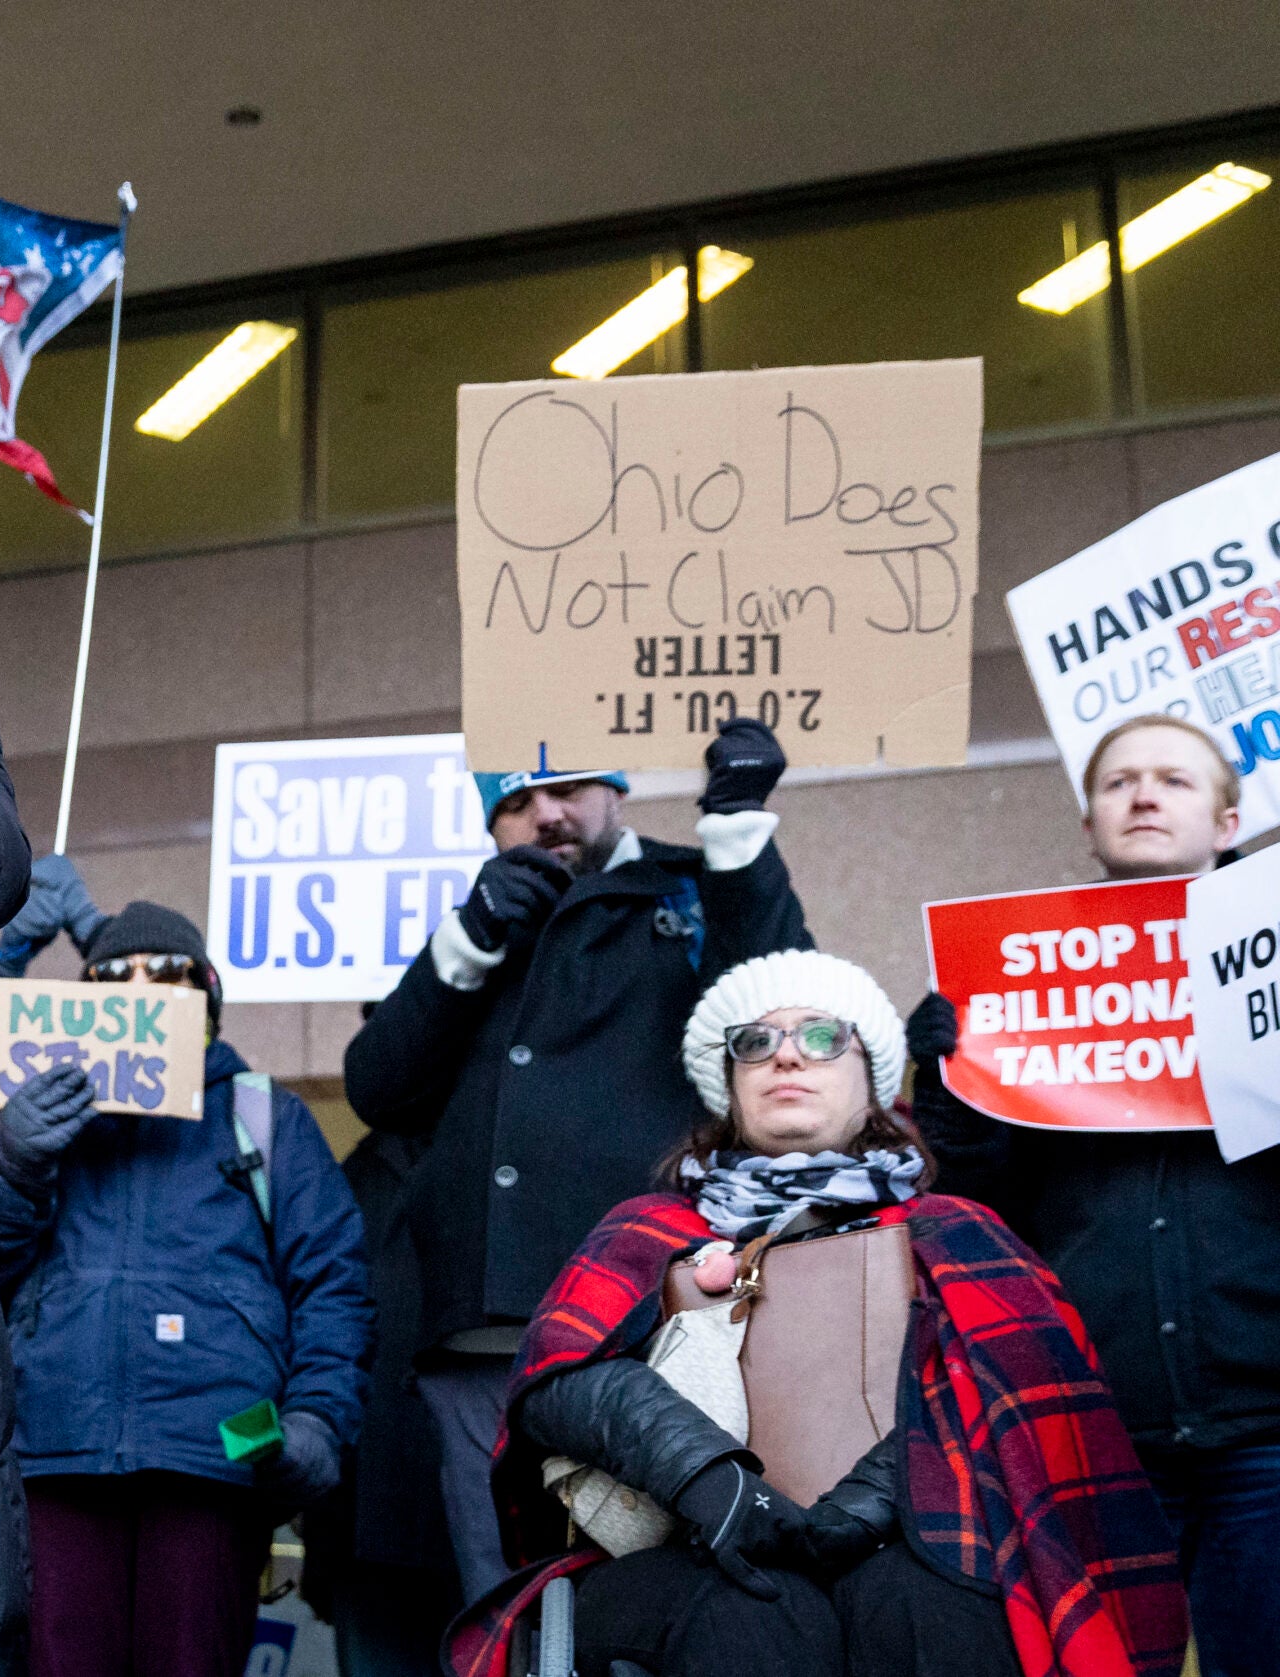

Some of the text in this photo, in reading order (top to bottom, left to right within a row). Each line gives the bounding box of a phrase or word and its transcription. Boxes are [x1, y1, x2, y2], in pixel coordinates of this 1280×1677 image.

[474, 390, 959, 552] Ohio Does
[485, 544, 962, 635] Not Claim JD
[1048, 541, 1255, 674] HANDS
[634, 634, 781, 677] LETTER
[1074, 580, 1280, 722] OUR RES
[596, 692, 654, 734] FT.
[759, 690, 822, 732] 2.0
[233, 762, 408, 859] Save
[228, 873, 355, 970] U.S.
[999, 923, 1137, 977] STOP
[1210, 924, 1280, 987] WO
[9, 993, 168, 1046] MUSK
[993, 1034, 1199, 1087] TAKEOV
